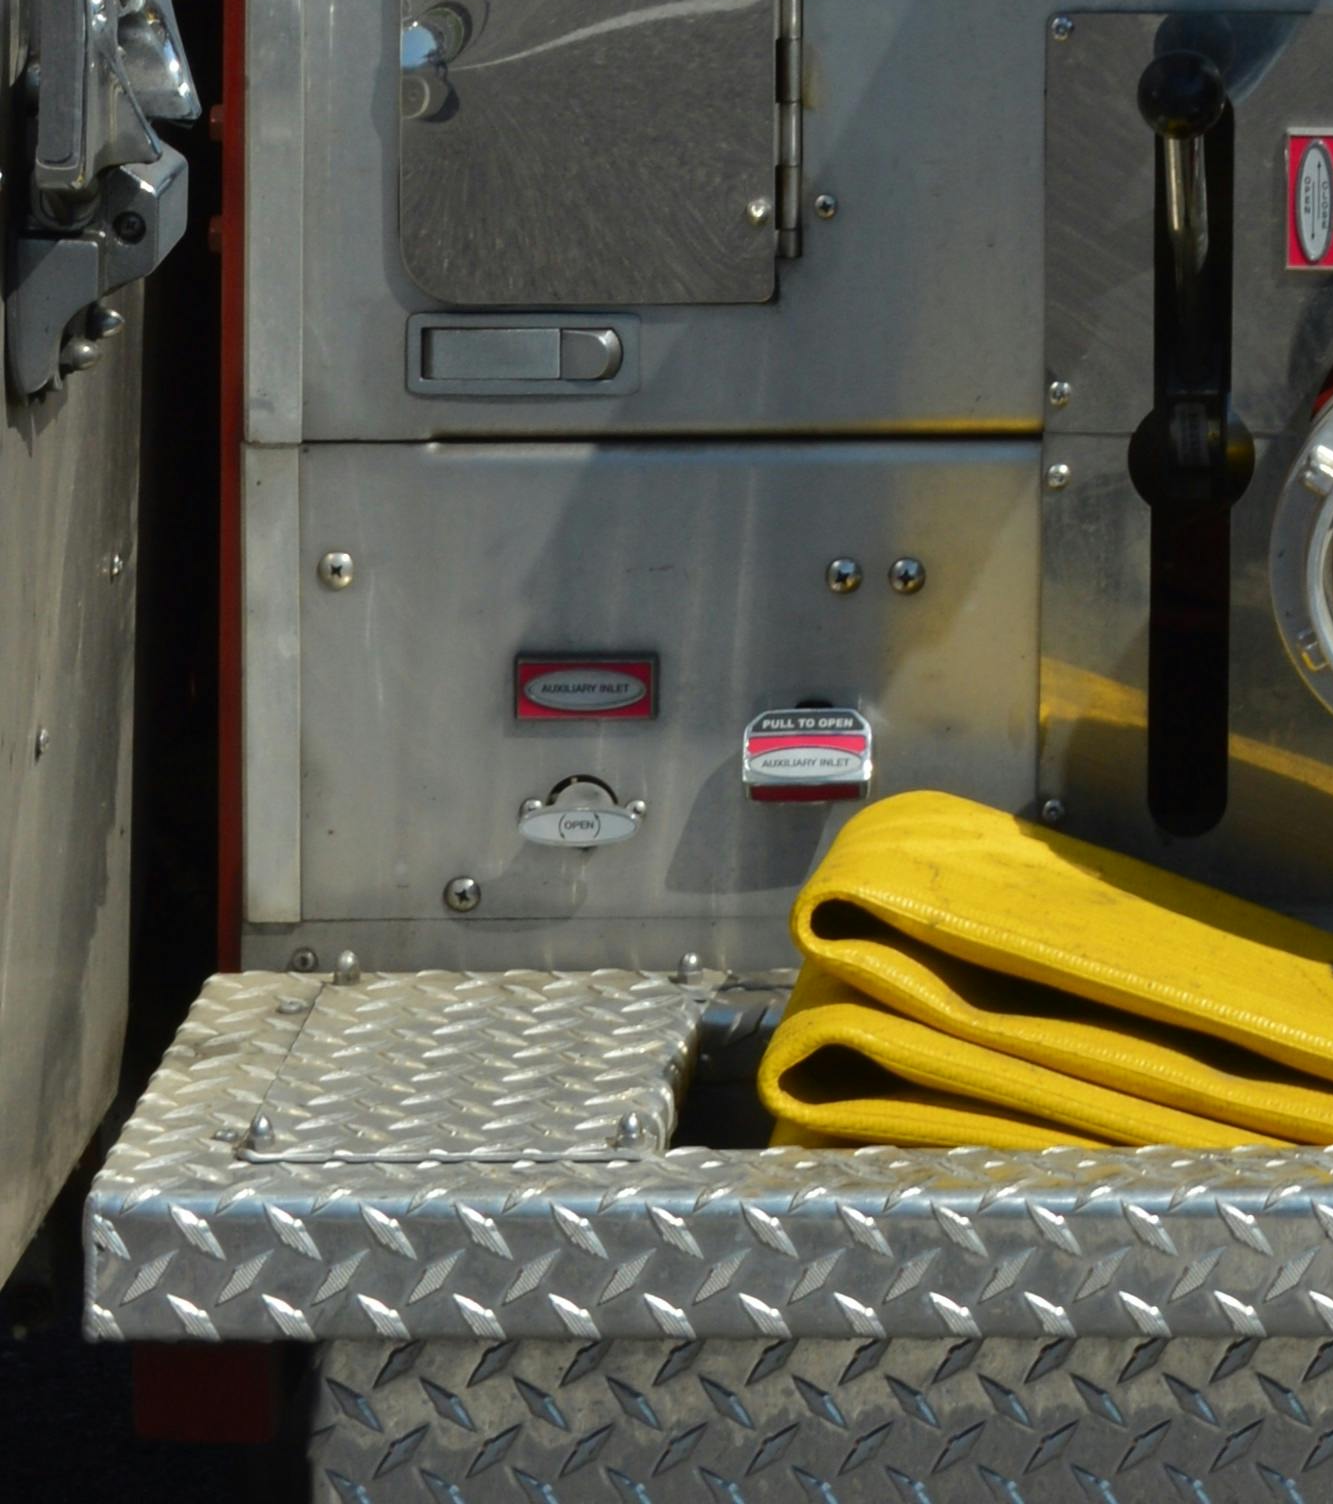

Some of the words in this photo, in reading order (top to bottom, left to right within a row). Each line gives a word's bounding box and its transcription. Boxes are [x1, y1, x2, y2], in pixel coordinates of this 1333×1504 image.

[542, 683, 597, 695] AUXILIARY
[599, 683, 629, 694] INLET
[762, 719, 793, 729] PULL
[798, 718, 814, 728] TO
[819, 718, 853, 728] OPEN
[762, 758, 817, 768] AUXILIARY
[820, 757, 850, 767] INLET
[564, 820, 595, 830] OPEN
